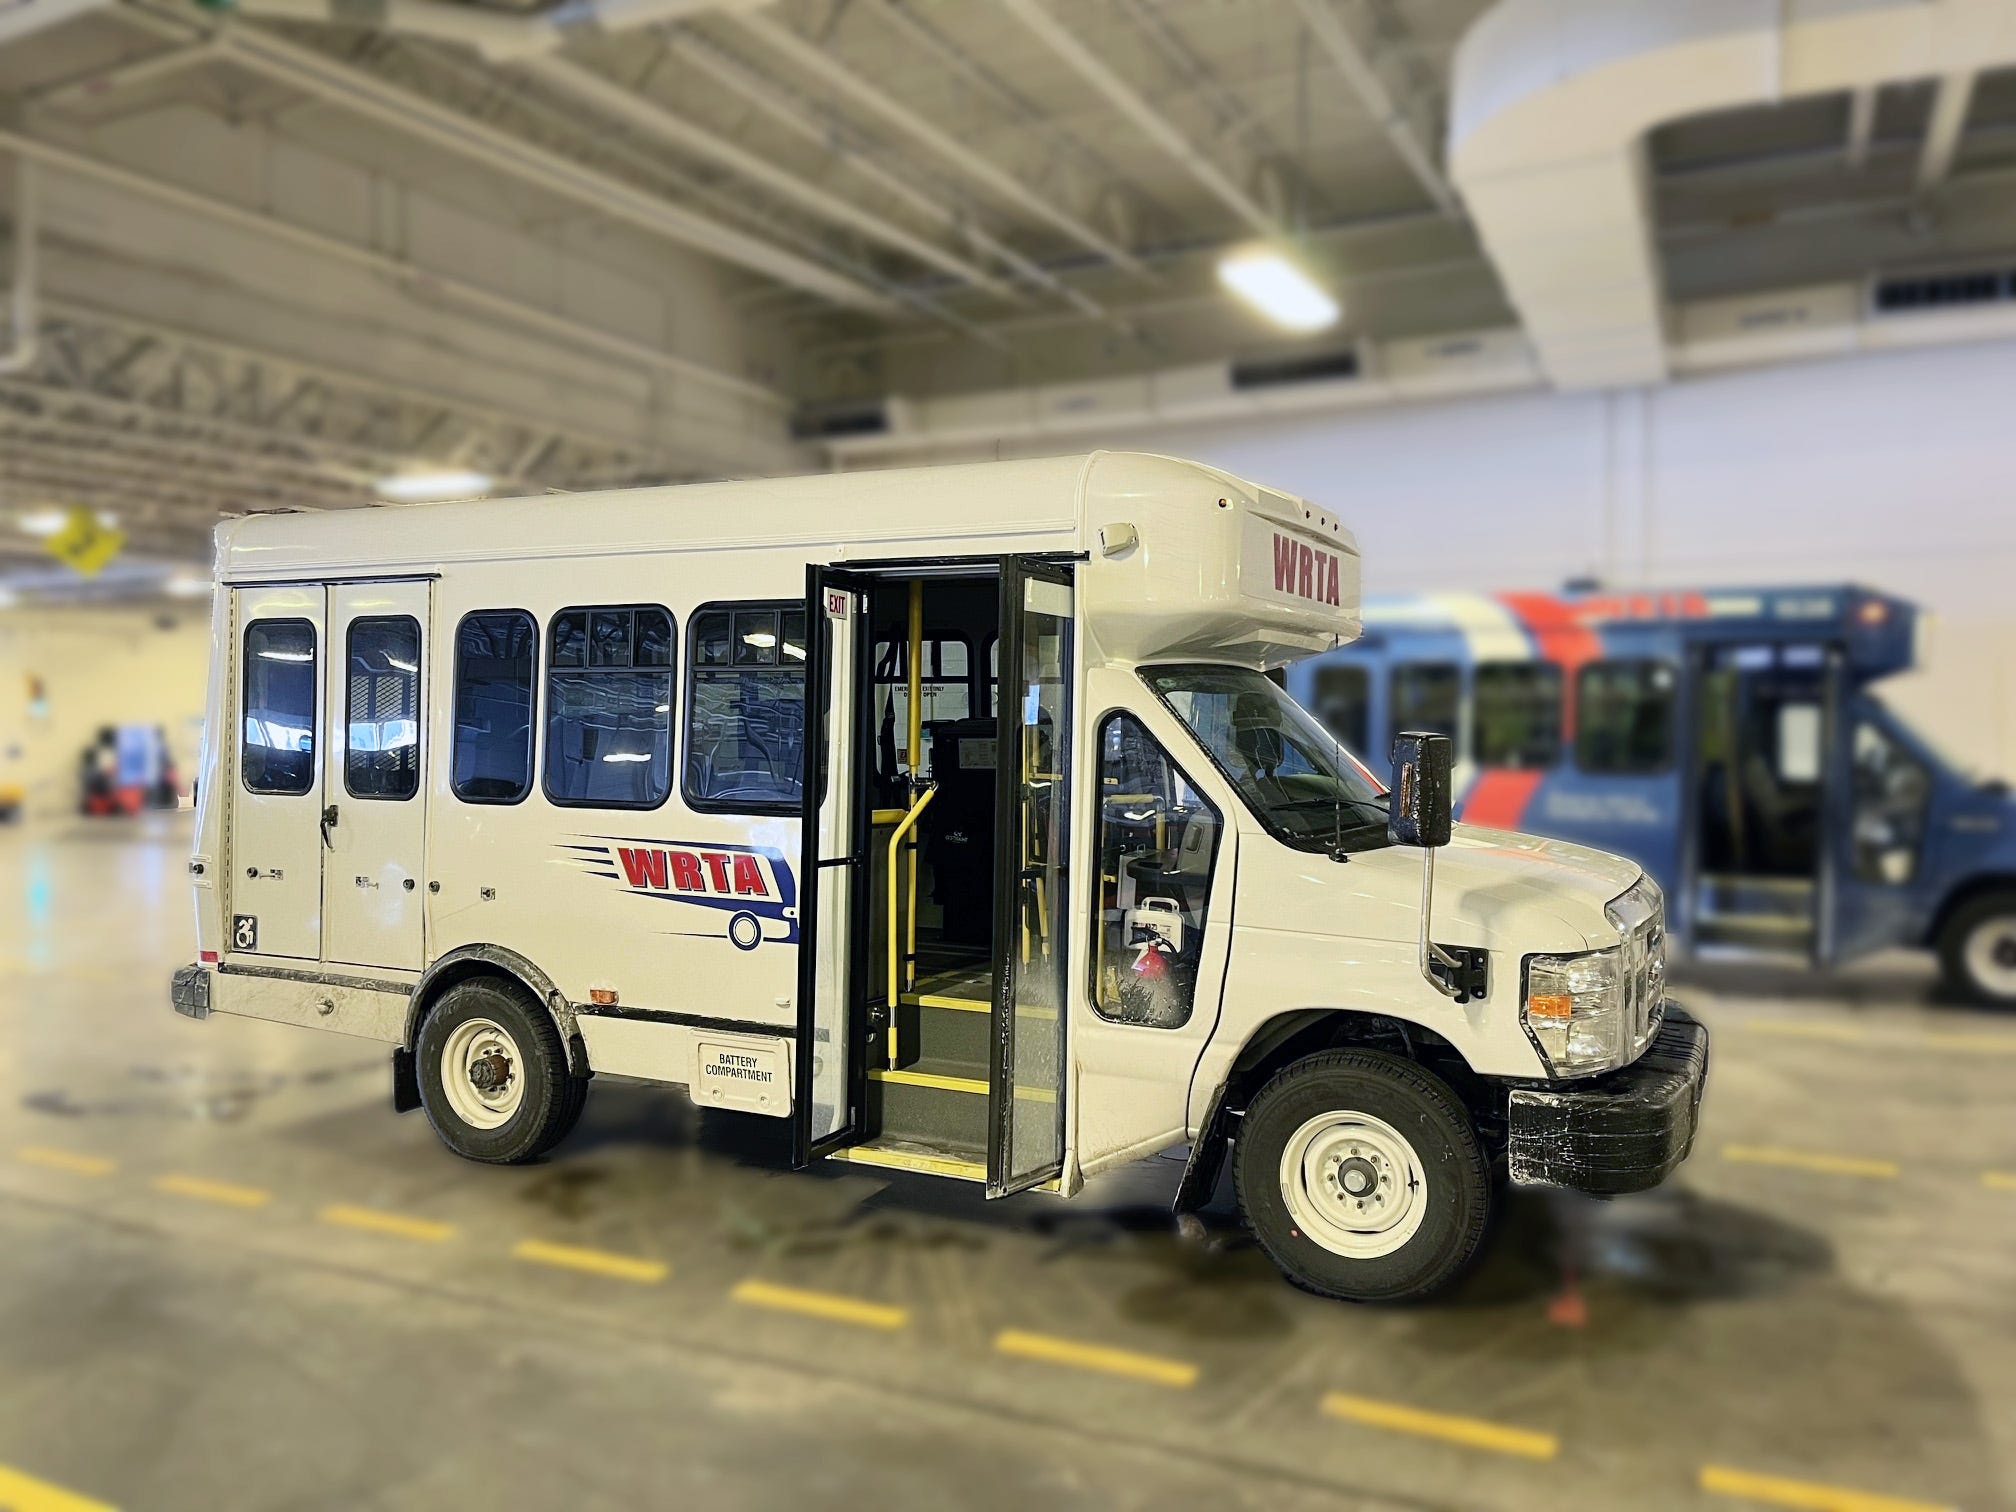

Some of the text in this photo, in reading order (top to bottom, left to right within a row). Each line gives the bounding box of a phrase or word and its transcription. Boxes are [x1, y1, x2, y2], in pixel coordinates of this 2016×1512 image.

[1273, 532, 1339, 607] WRTA
[829, 594, 845, 614] EXIT
[617, 847, 769, 896] WRTA
[719, 1053, 758, 1069] BATTERY
[705, 1064, 773, 1083] COMPARTMENT
